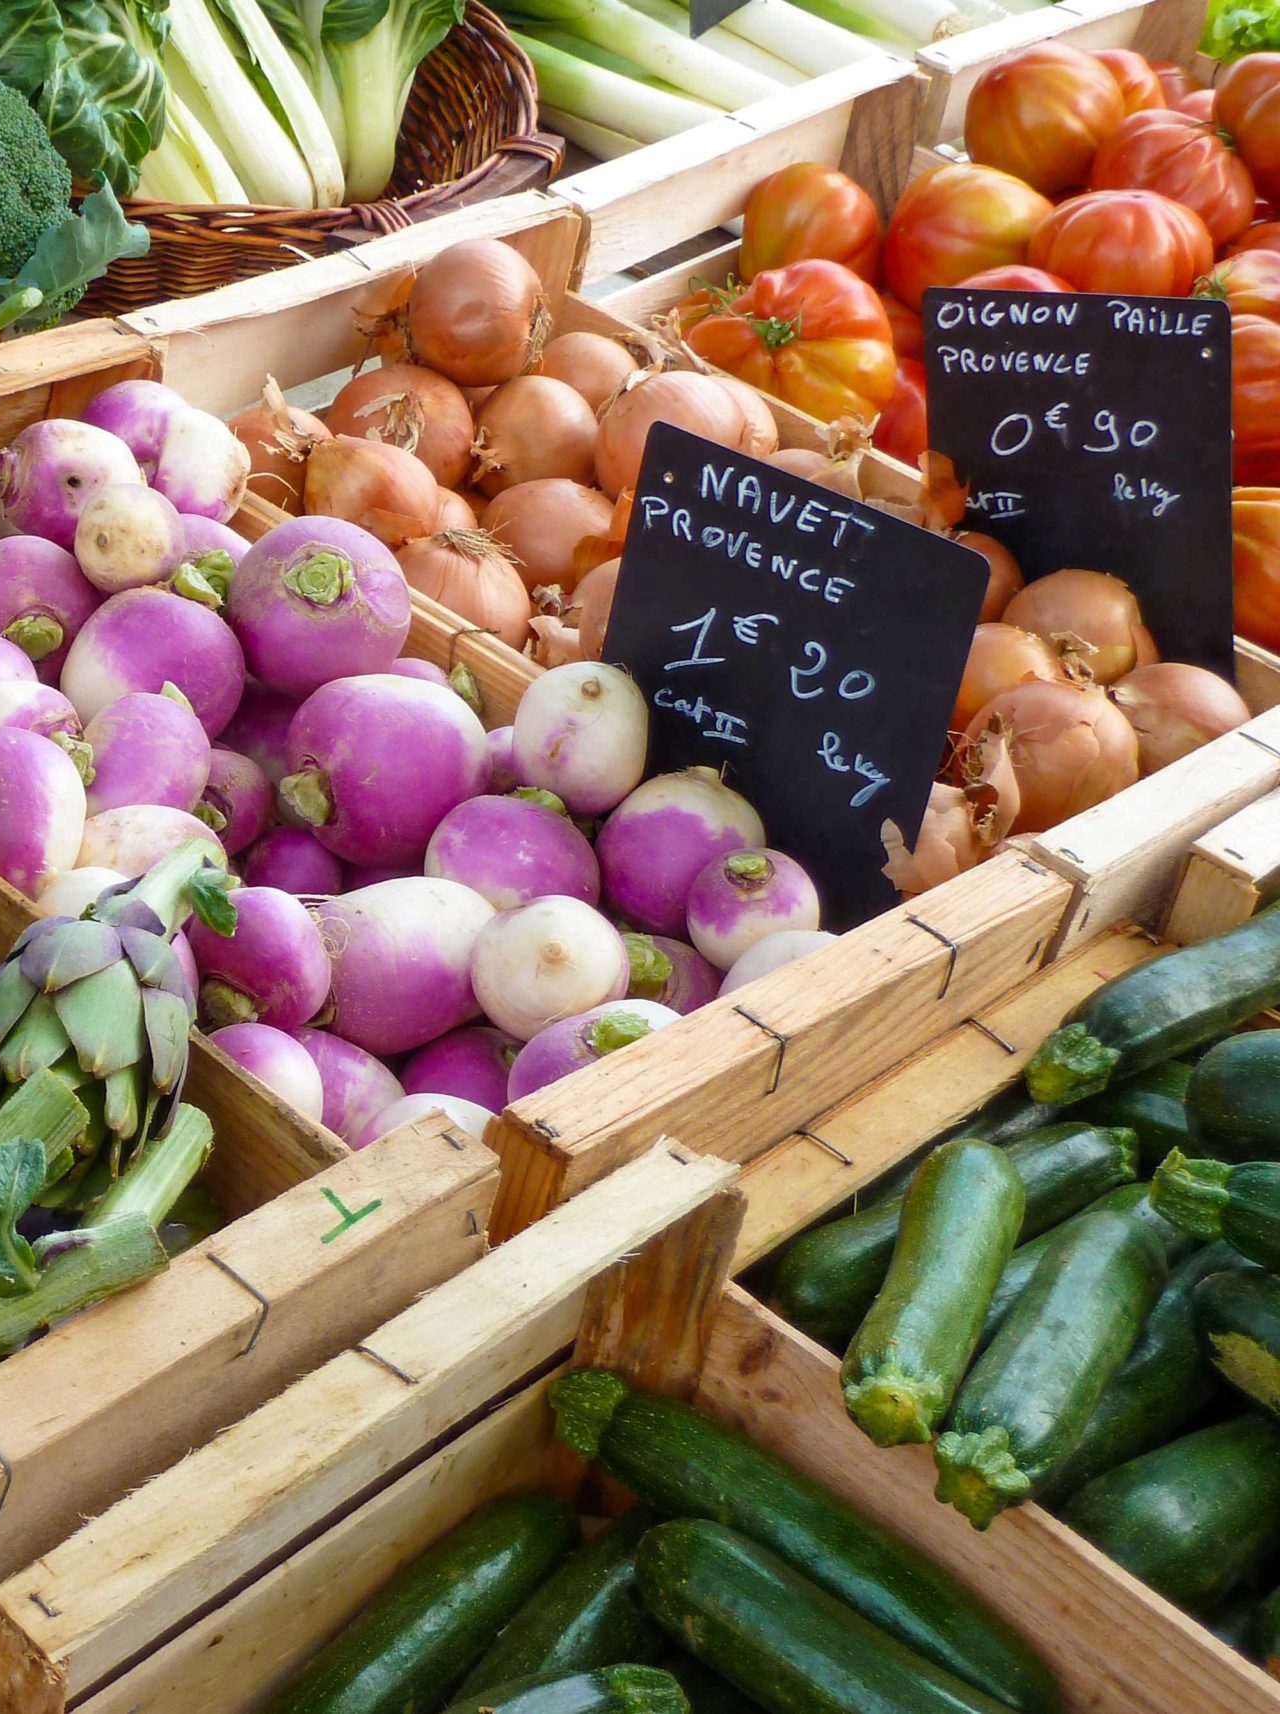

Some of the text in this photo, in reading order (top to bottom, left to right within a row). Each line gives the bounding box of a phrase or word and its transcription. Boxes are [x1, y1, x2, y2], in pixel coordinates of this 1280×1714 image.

[937, 346, 1091, 376] PROVENCE
[700, 463, 876, 549] NAVET
[641, 496, 856, 603] PROVENCE
